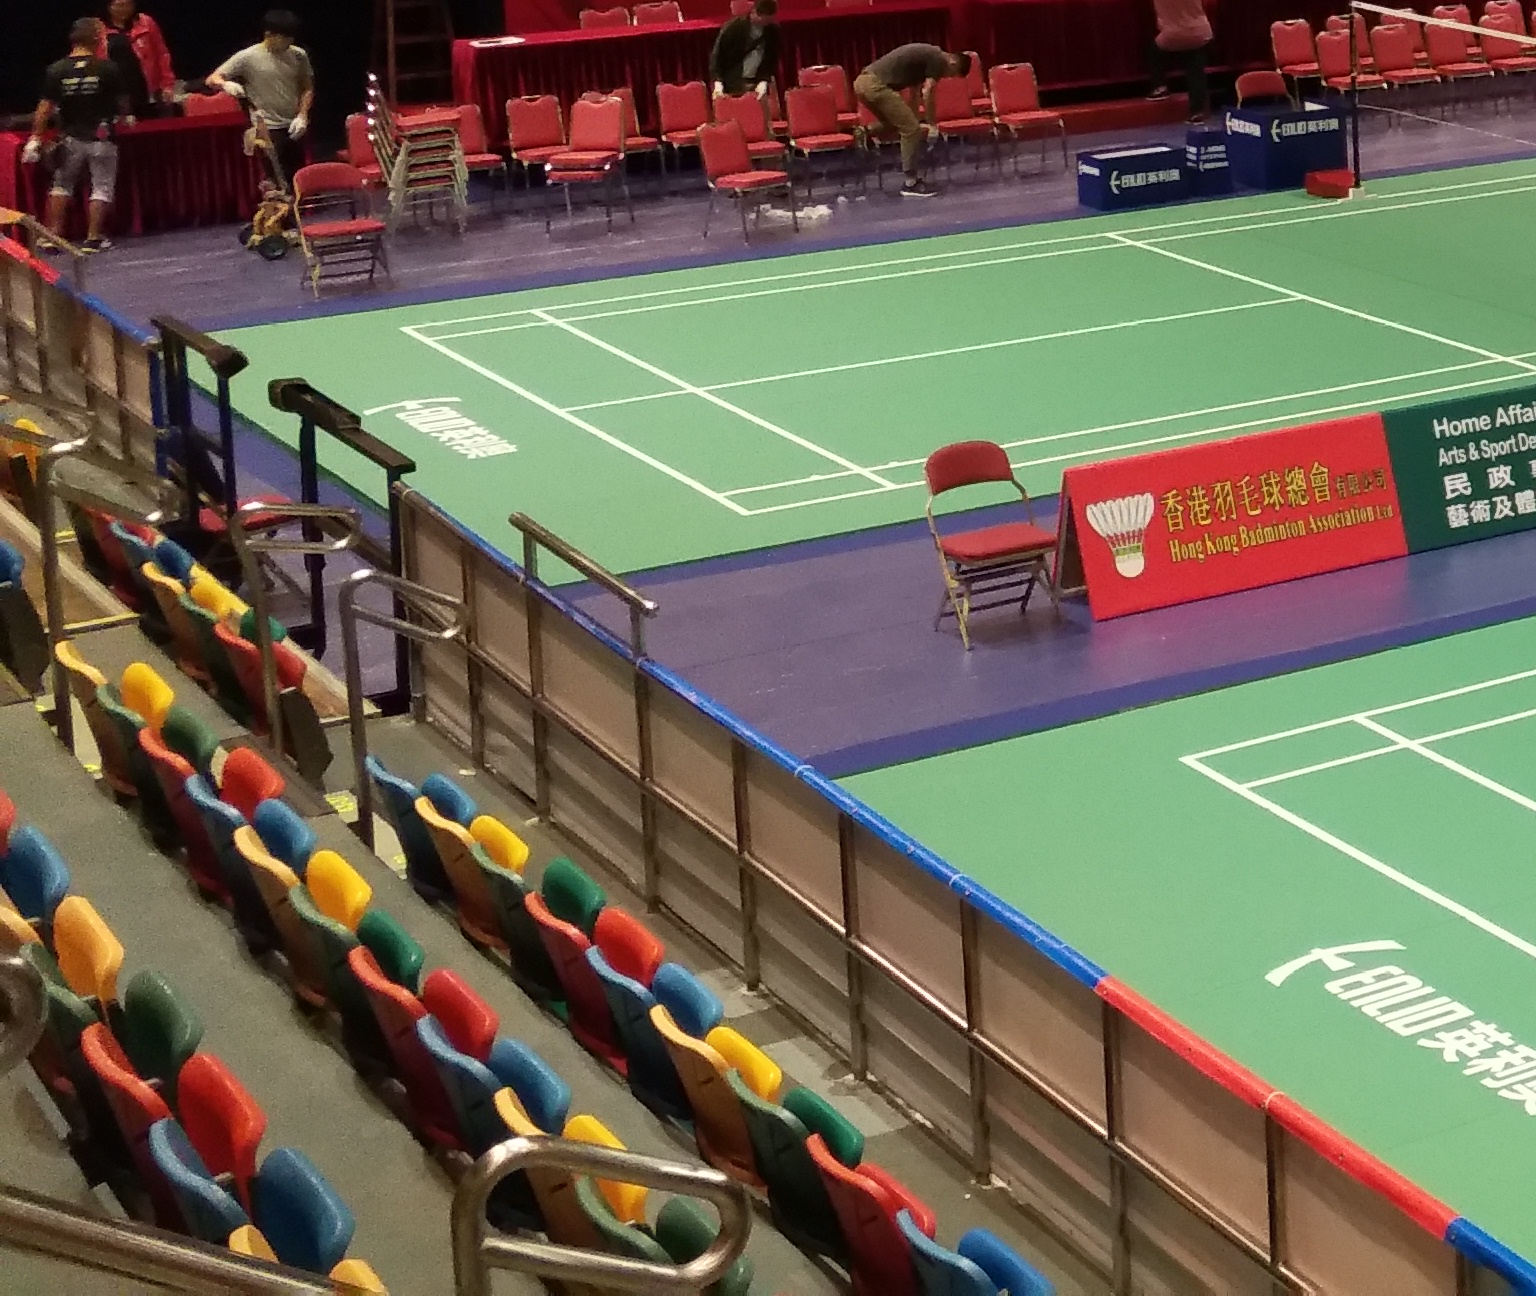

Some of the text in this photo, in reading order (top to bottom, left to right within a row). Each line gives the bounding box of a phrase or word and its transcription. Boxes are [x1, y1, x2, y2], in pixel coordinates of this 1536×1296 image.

[1433, 413, 1492, 439] Home
[1438, 448, 1467, 468] Arts
[1469, 444, 1479, 461] &
[1480, 435, 1517, 462] Sport
[1160, 461, 1387, 533] 香港羽毛球總會 有限公司
[1169, 504, 1394, 564] Hong Kong Badminton Association Ltd
[1324, 964, 1475, 1037] ENLIO
